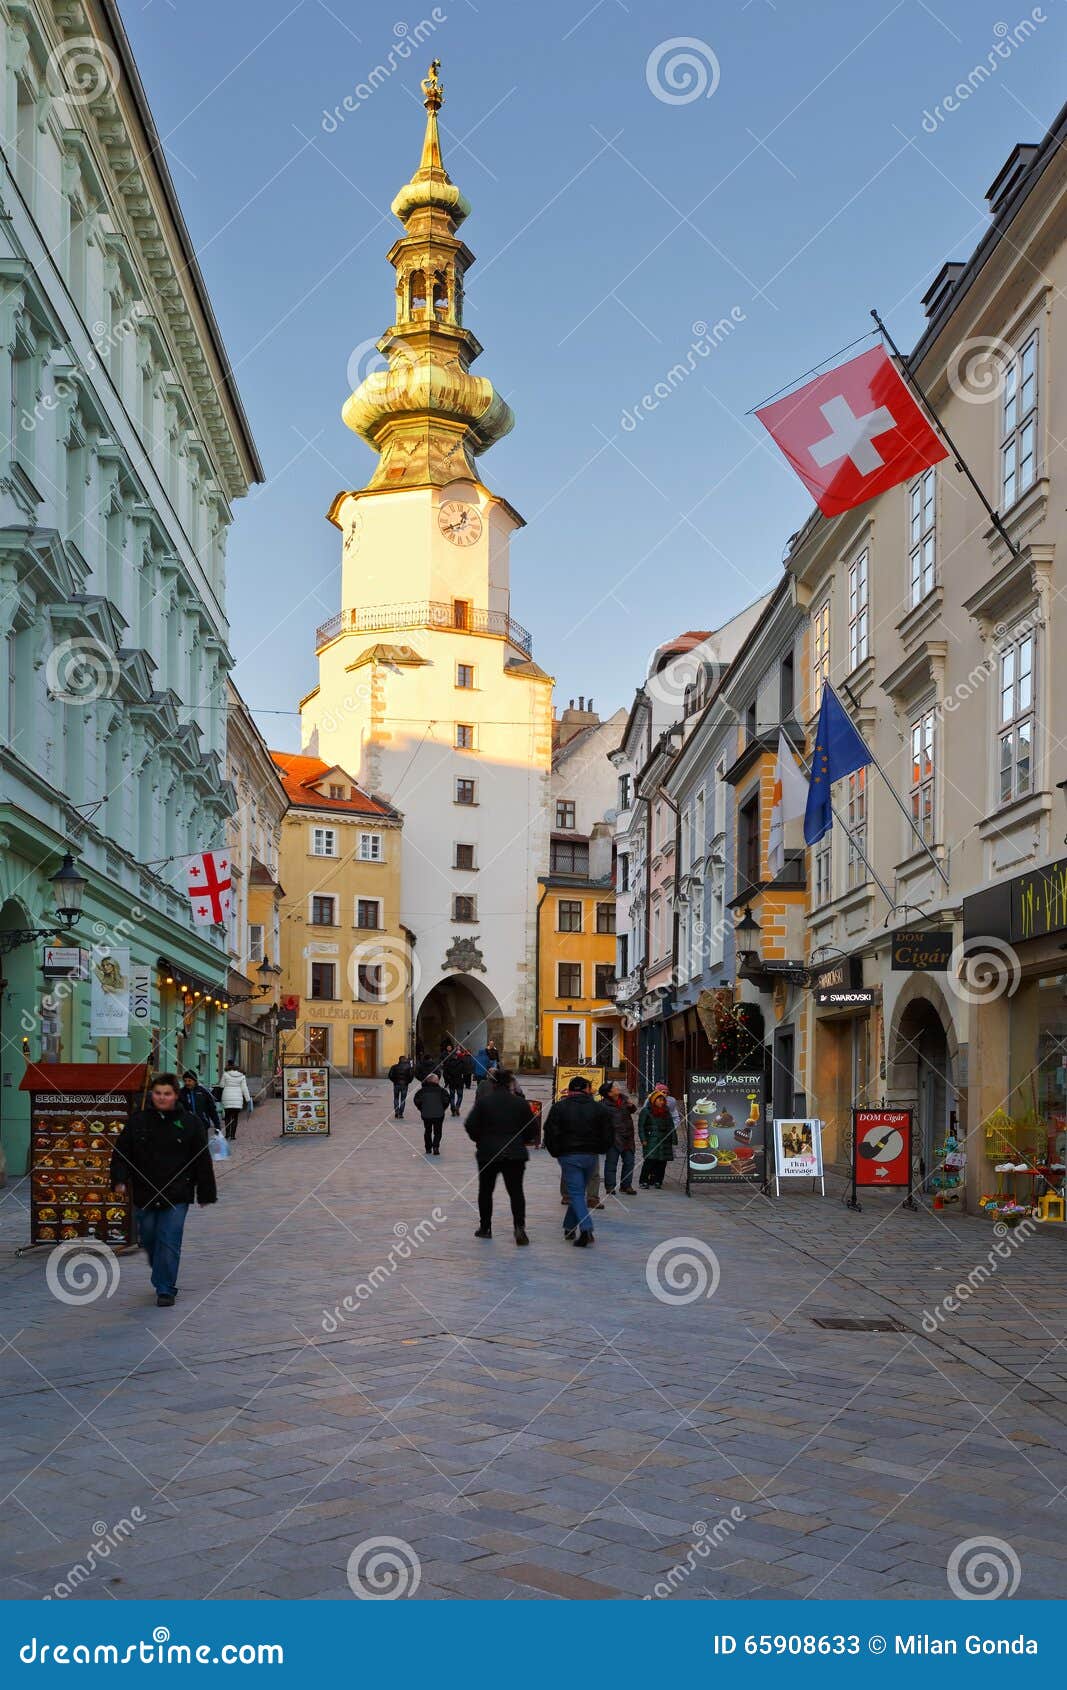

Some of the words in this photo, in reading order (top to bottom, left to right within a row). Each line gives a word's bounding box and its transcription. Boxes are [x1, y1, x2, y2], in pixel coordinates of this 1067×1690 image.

[895, 933, 925, 942] DOM
[895, 947, 949, 968] Cigár
[135, 976, 148, 1018] IVKO
[830, 993, 872, 1002] SWAROVSKI
[692, 1075, 717, 1084] SIMO
[726, 1075, 760, 1084] PASTRY
[860, 1113, 881, 1121] DOM
[883, 1113, 905, 1123] Cigár
